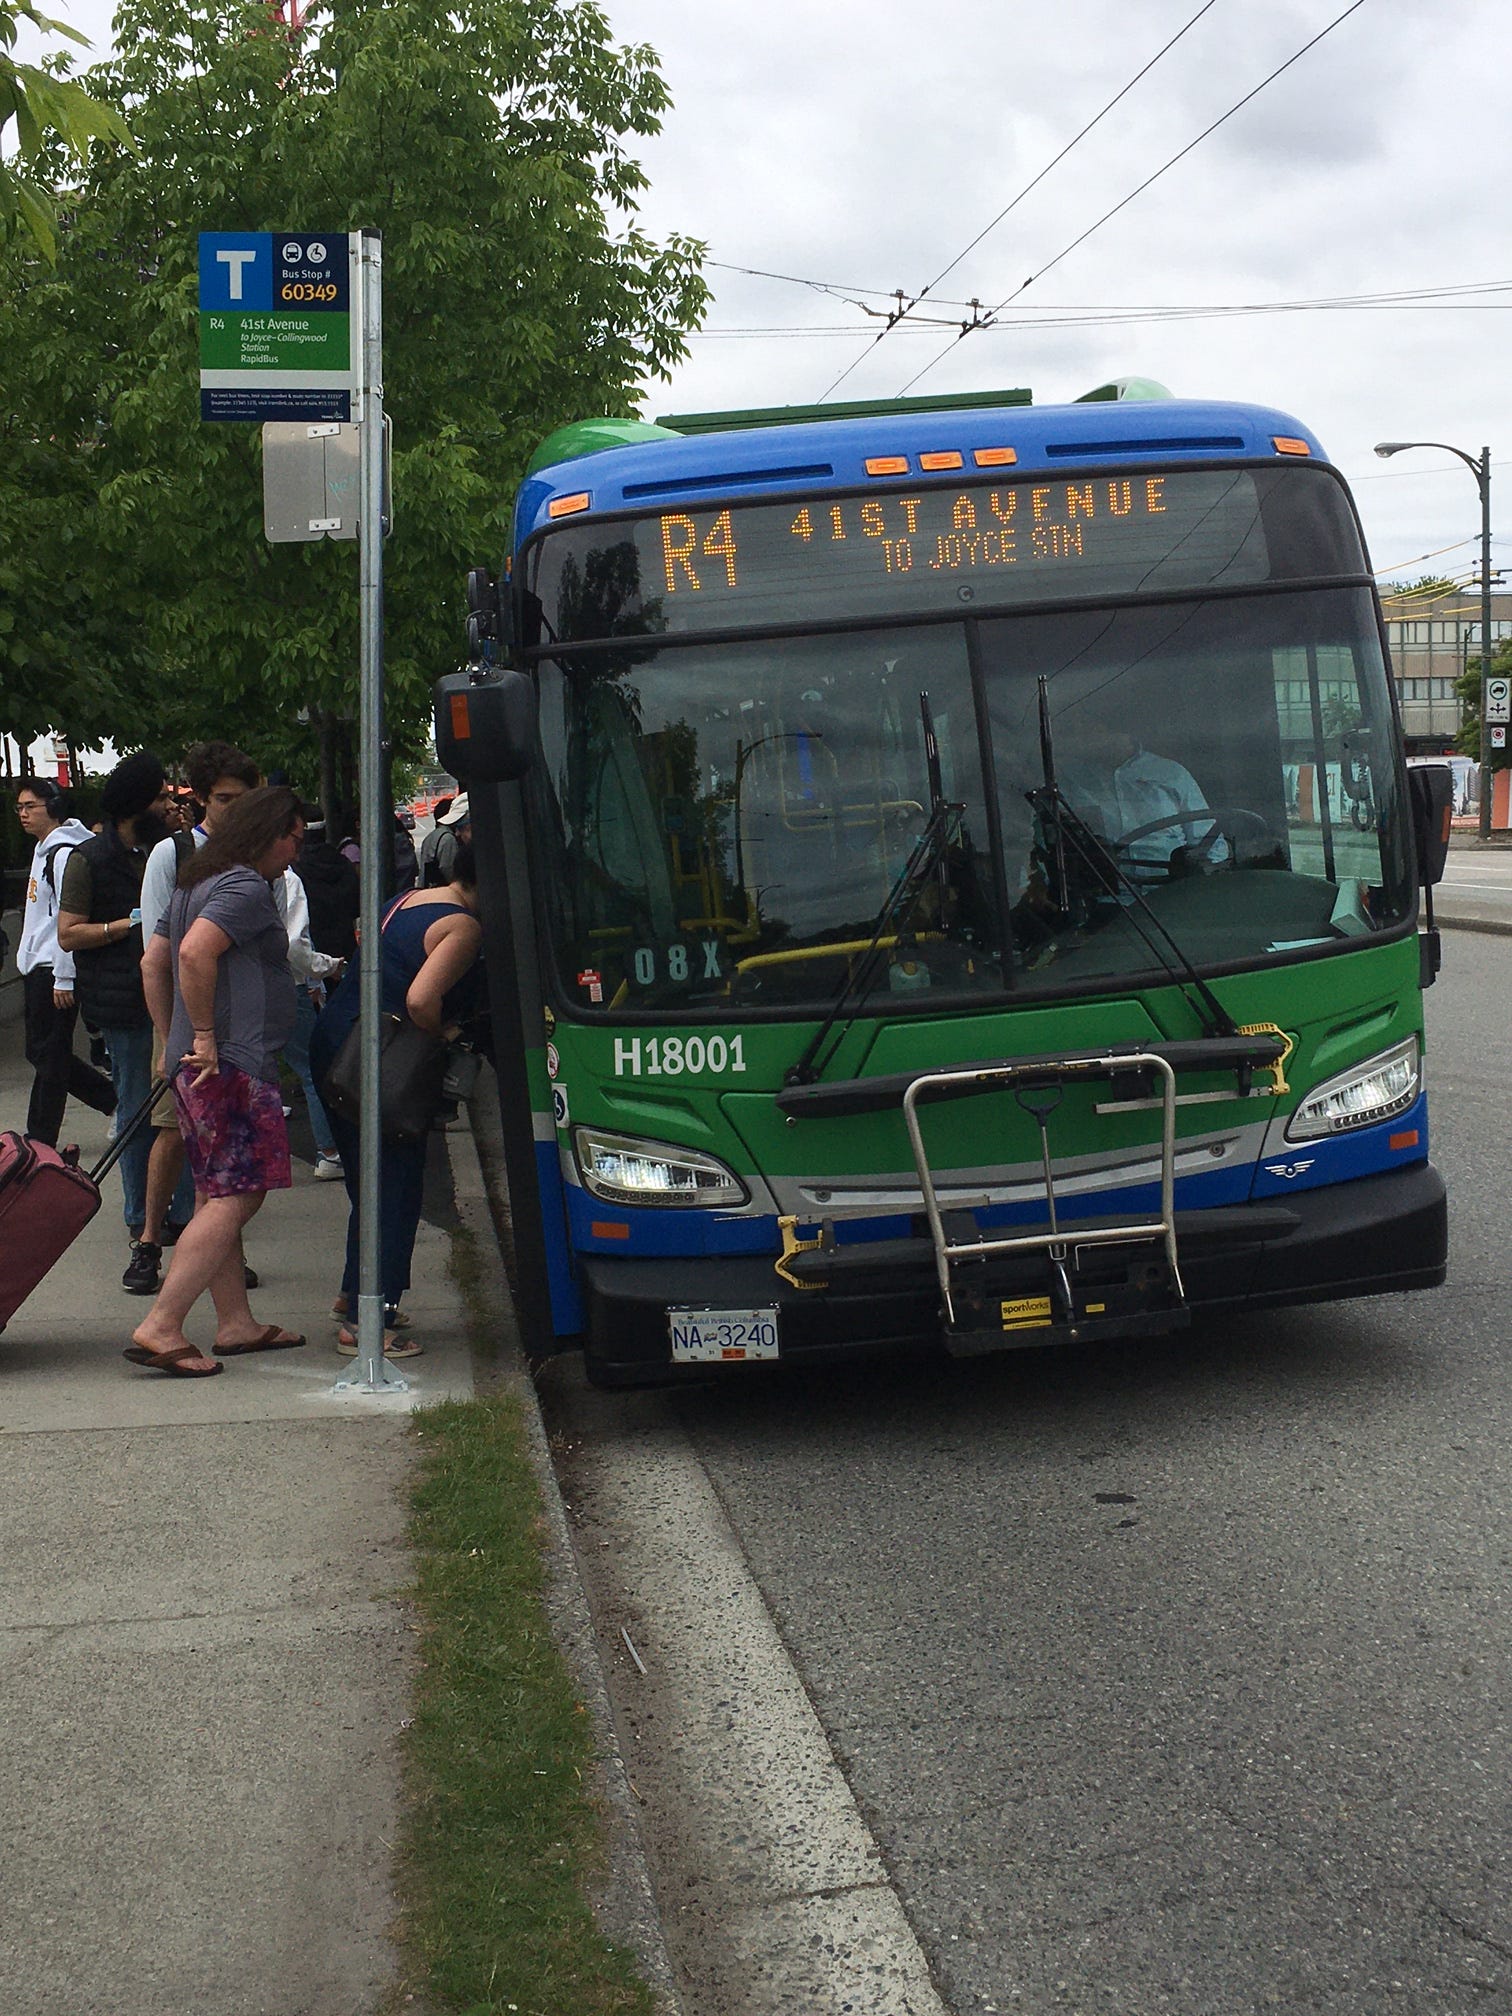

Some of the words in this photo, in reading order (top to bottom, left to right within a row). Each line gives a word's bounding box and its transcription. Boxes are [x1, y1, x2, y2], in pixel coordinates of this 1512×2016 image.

[216, 250, 257, 300] T
[282, 269, 300, 279] Bus
[301, 270, 323, 280] Stop
[325, 270, 331, 278] #
[281, 283, 337, 301] 60349
[210, 318, 225, 330] R4
[240, 318, 265, 330] 41st
[267, 319, 309, 330] Avenue
[240, 333, 249, 341] to
[240, 343, 270, 352] Station
[240, 354, 279, 365] RapidBus
[660, 509, 737, 593] R4
[790, 498, 921, 542] 41ST
[952, 478, 1167, 529] AVENUE
[881, 538, 913, 573] TO
[928, 529, 1017, 569] JOYCE
[1031, 523, 1083, 559] STN
[614, 1034, 746, 1076] H18001
[673, 1325, 703, 1349] NA
[717, 1323, 776, 1348] 3240
